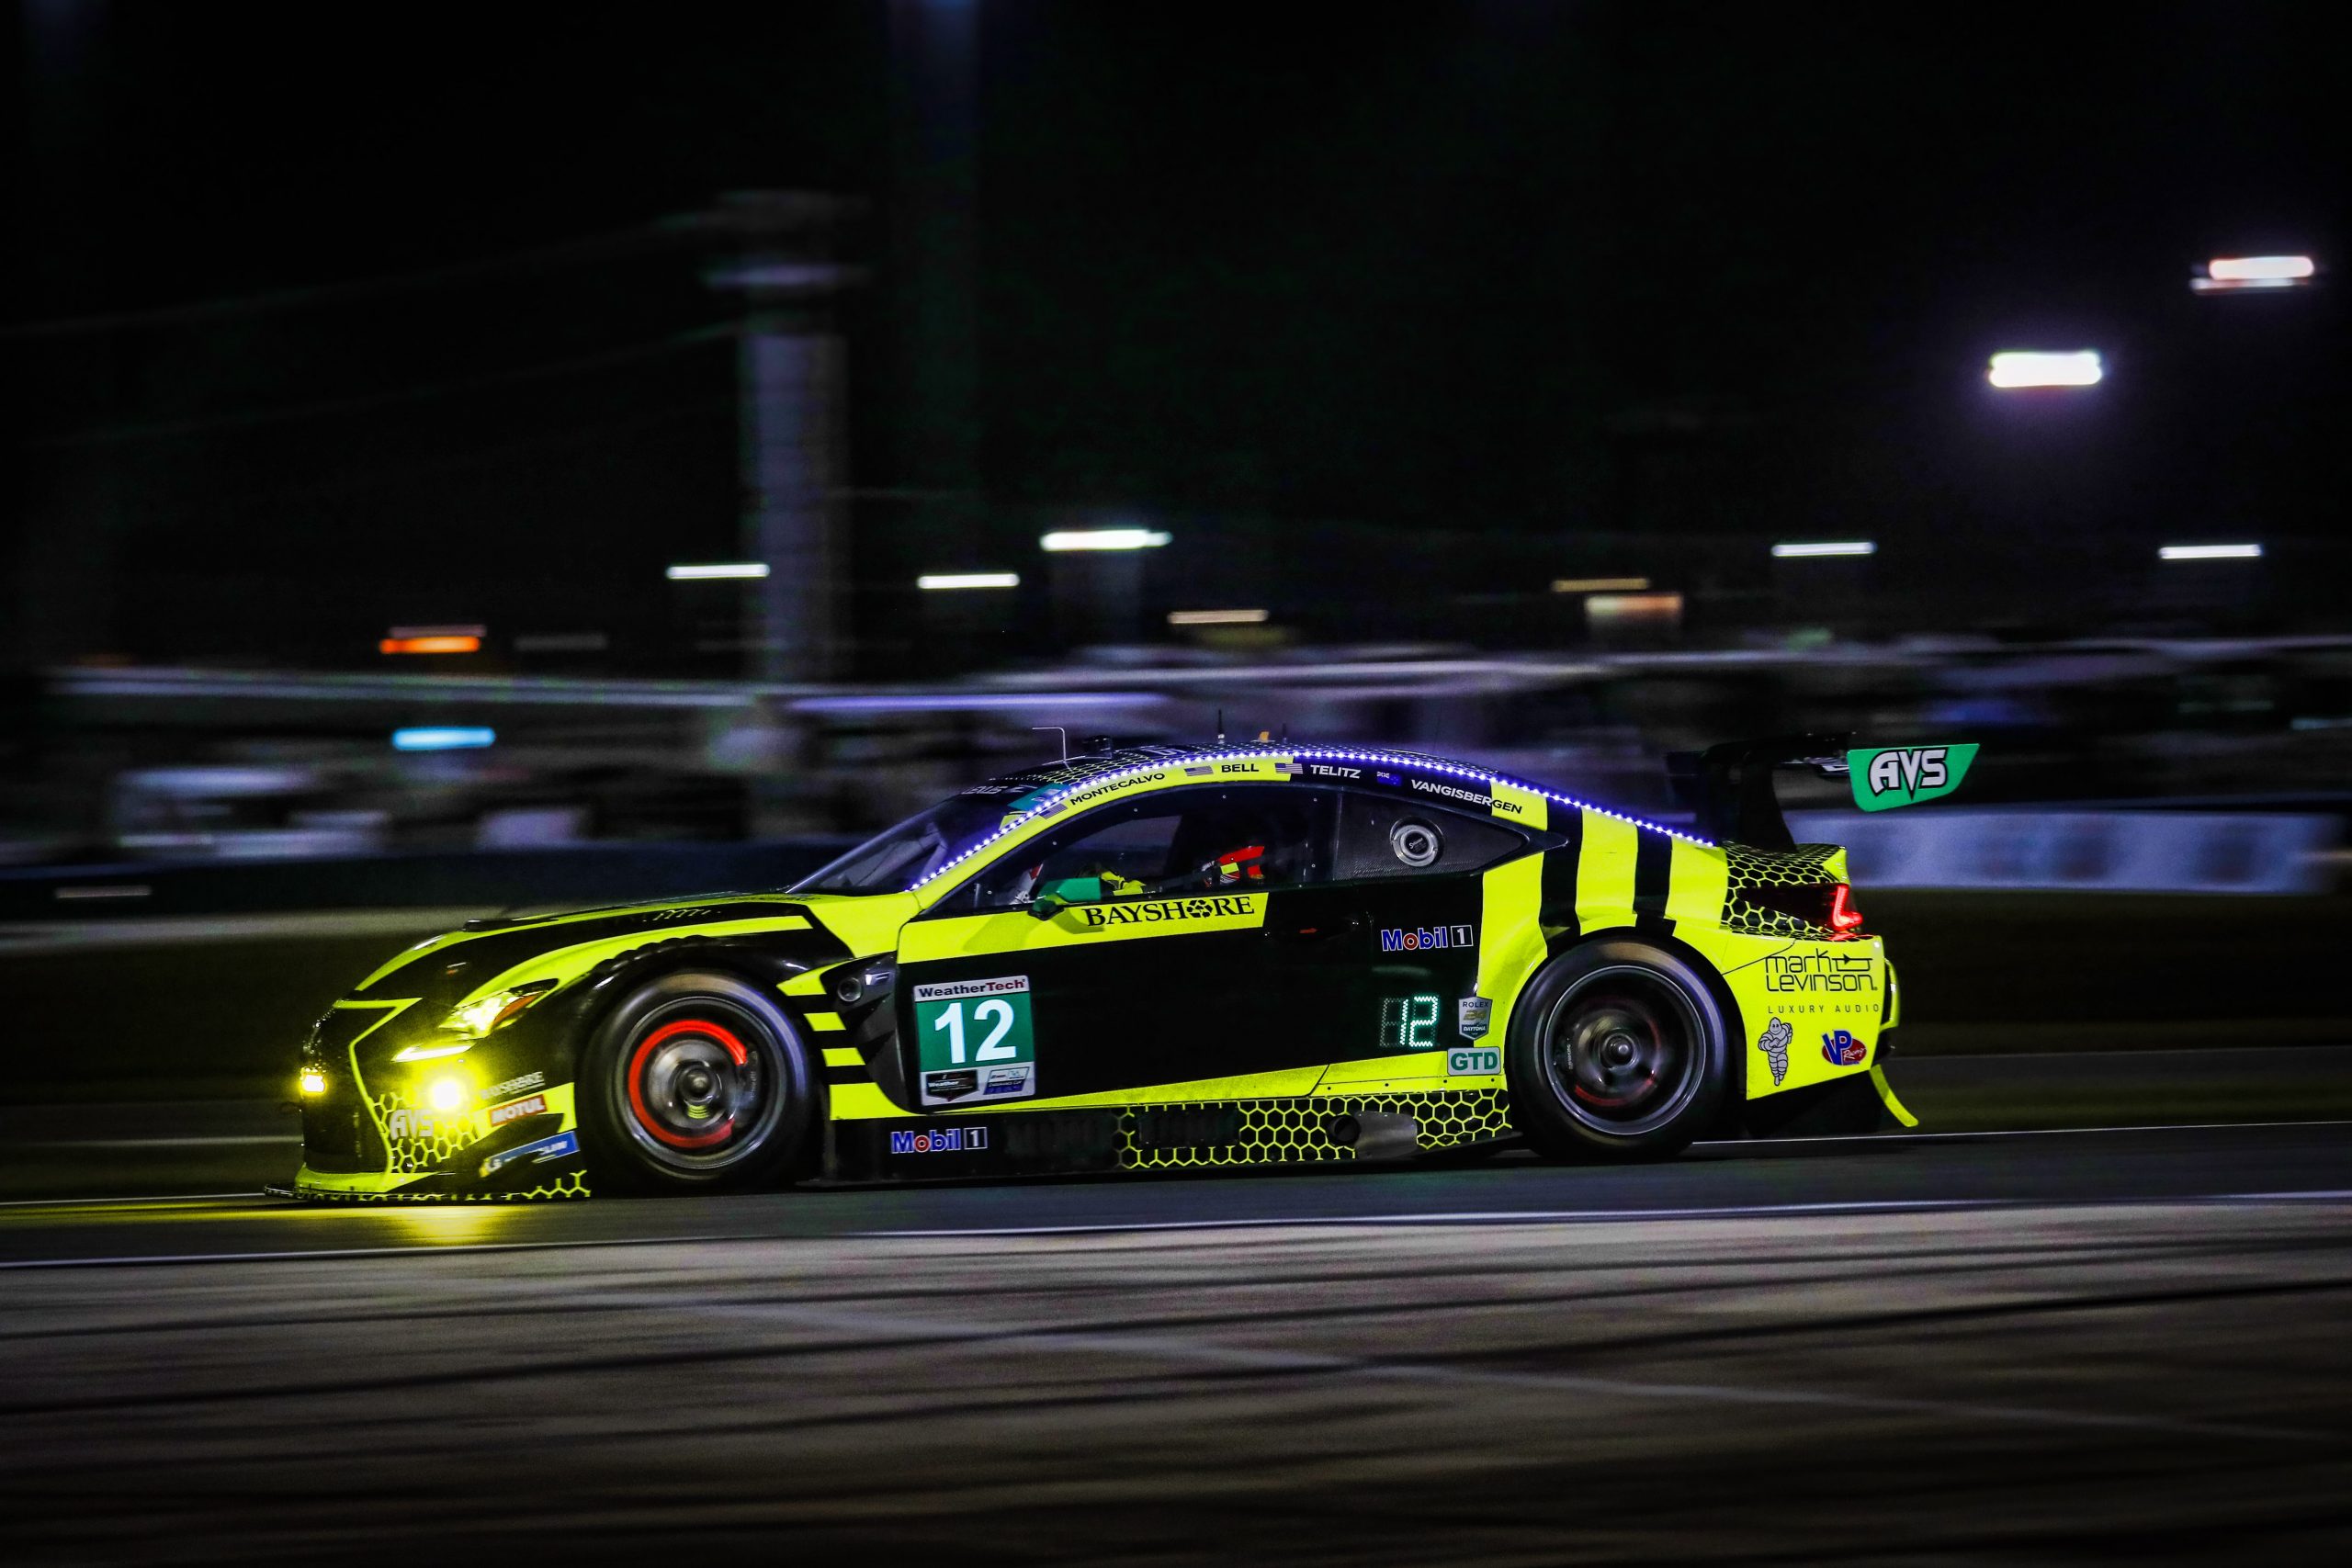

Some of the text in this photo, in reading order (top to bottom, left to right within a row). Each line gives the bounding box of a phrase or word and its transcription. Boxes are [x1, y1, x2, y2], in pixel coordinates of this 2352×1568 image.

[1221, 763, 1259, 773] BELL
[1310, 764, 1362, 779] TELITZ
[1869, 748, 1949, 800] AVS
[1070, 773, 1165, 806] MONTECALVO
[1411, 779, 1522, 814] VANGISBERGEN
[1082, 896, 1255, 927] BAYSHORE
[1381, 926, 1448, 952] Mobil
[919, 978, 1026, 998] WeatherTech
[1400, 996, 1439, 1047] 12
[1769, 1004, 1880, 1014] LUXURY AUDIO
[934, 999, 1016, 1064] 12
[1822, 1029, 1853, 1066] VP
[1451, 1052, 1498, 1070] GTD
[492, 1098, 545, 1123] MOTUL
[891, 1128, 961, 1154] Mobil
